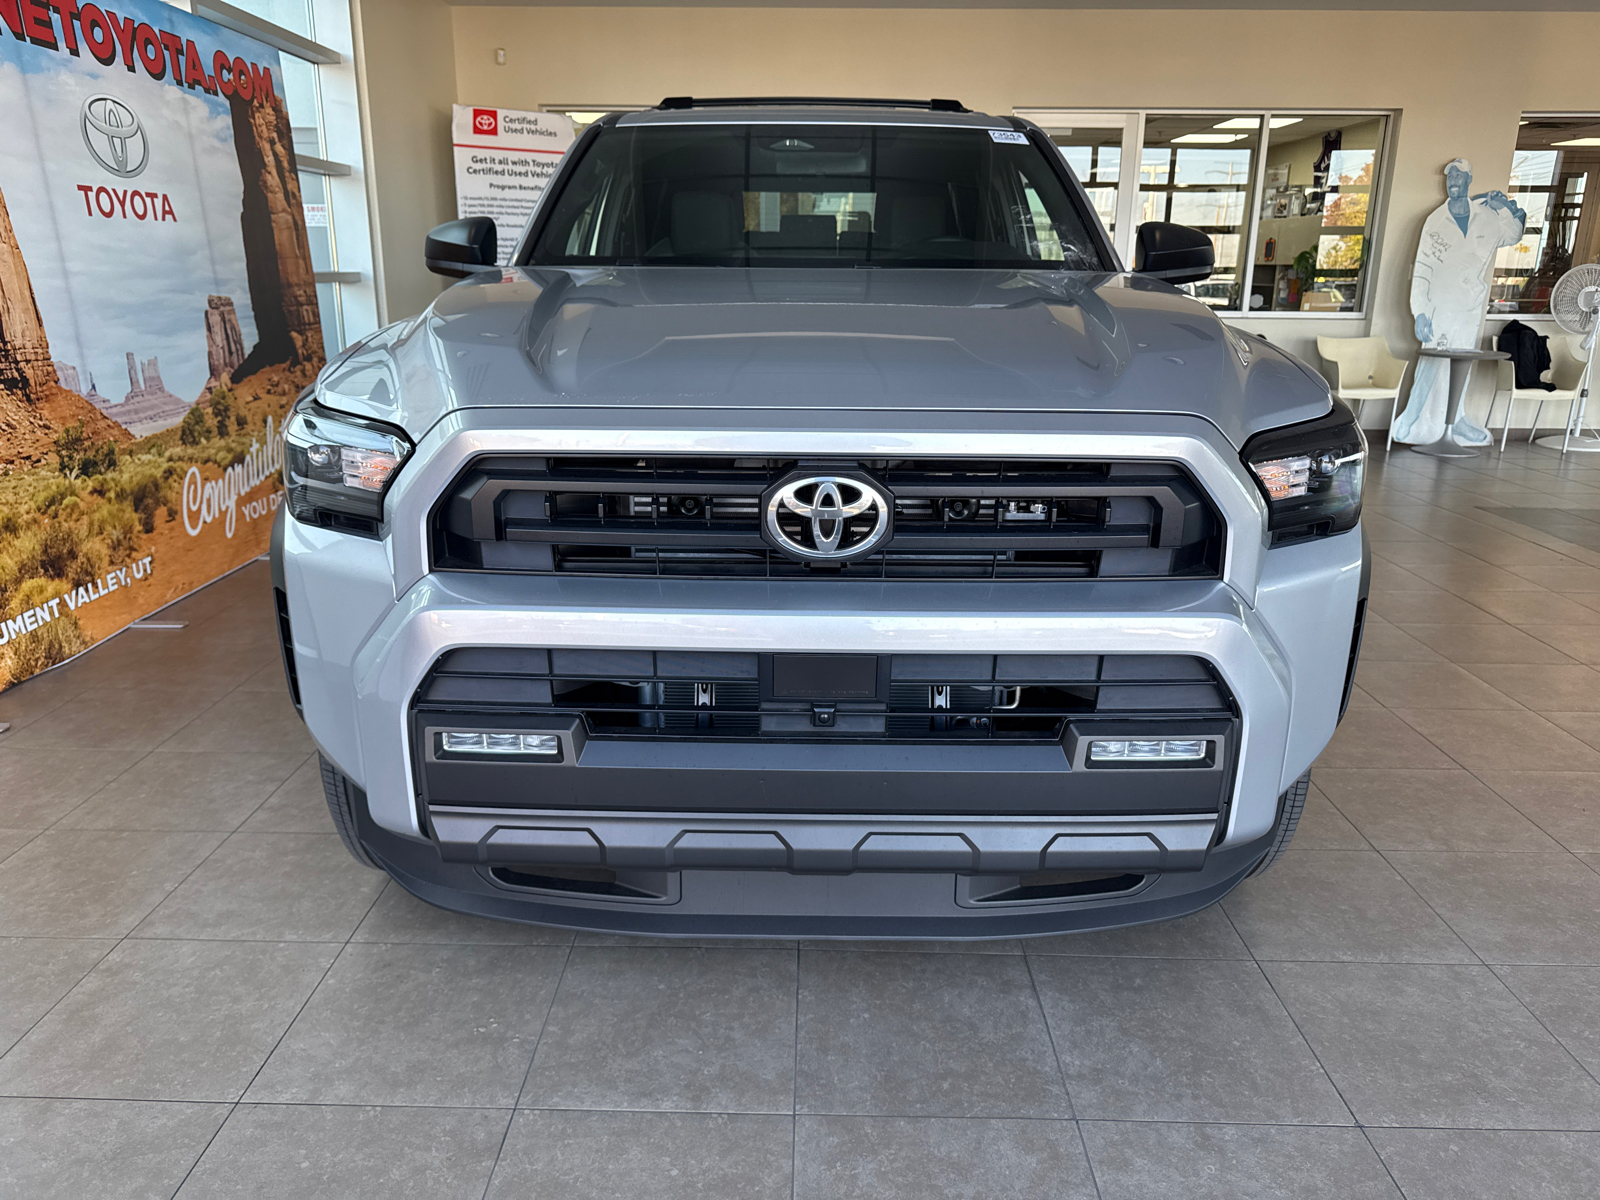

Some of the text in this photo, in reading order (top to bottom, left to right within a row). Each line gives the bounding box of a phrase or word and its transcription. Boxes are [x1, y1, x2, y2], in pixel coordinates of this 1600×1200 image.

[503, 115, 538, 126] Certified
[503, 125, 558, 138] Used Vehicles
[471, 155, 488, 165] Get
[489, 157, 496, 166] it
[499, 157, 509, 166] all
[511, 158, 530, 167] with
[466, 166, 505, 176] Certified
[507, 168, 529, 178] Used
[489, 183, 517, 191] Program
[77, 184, 177, 222] TOYOTA
[241, 497, 267, 522] YOU
[63, 567, 131, 611] VALLEY,
[132, 556, 152, 579] UT
